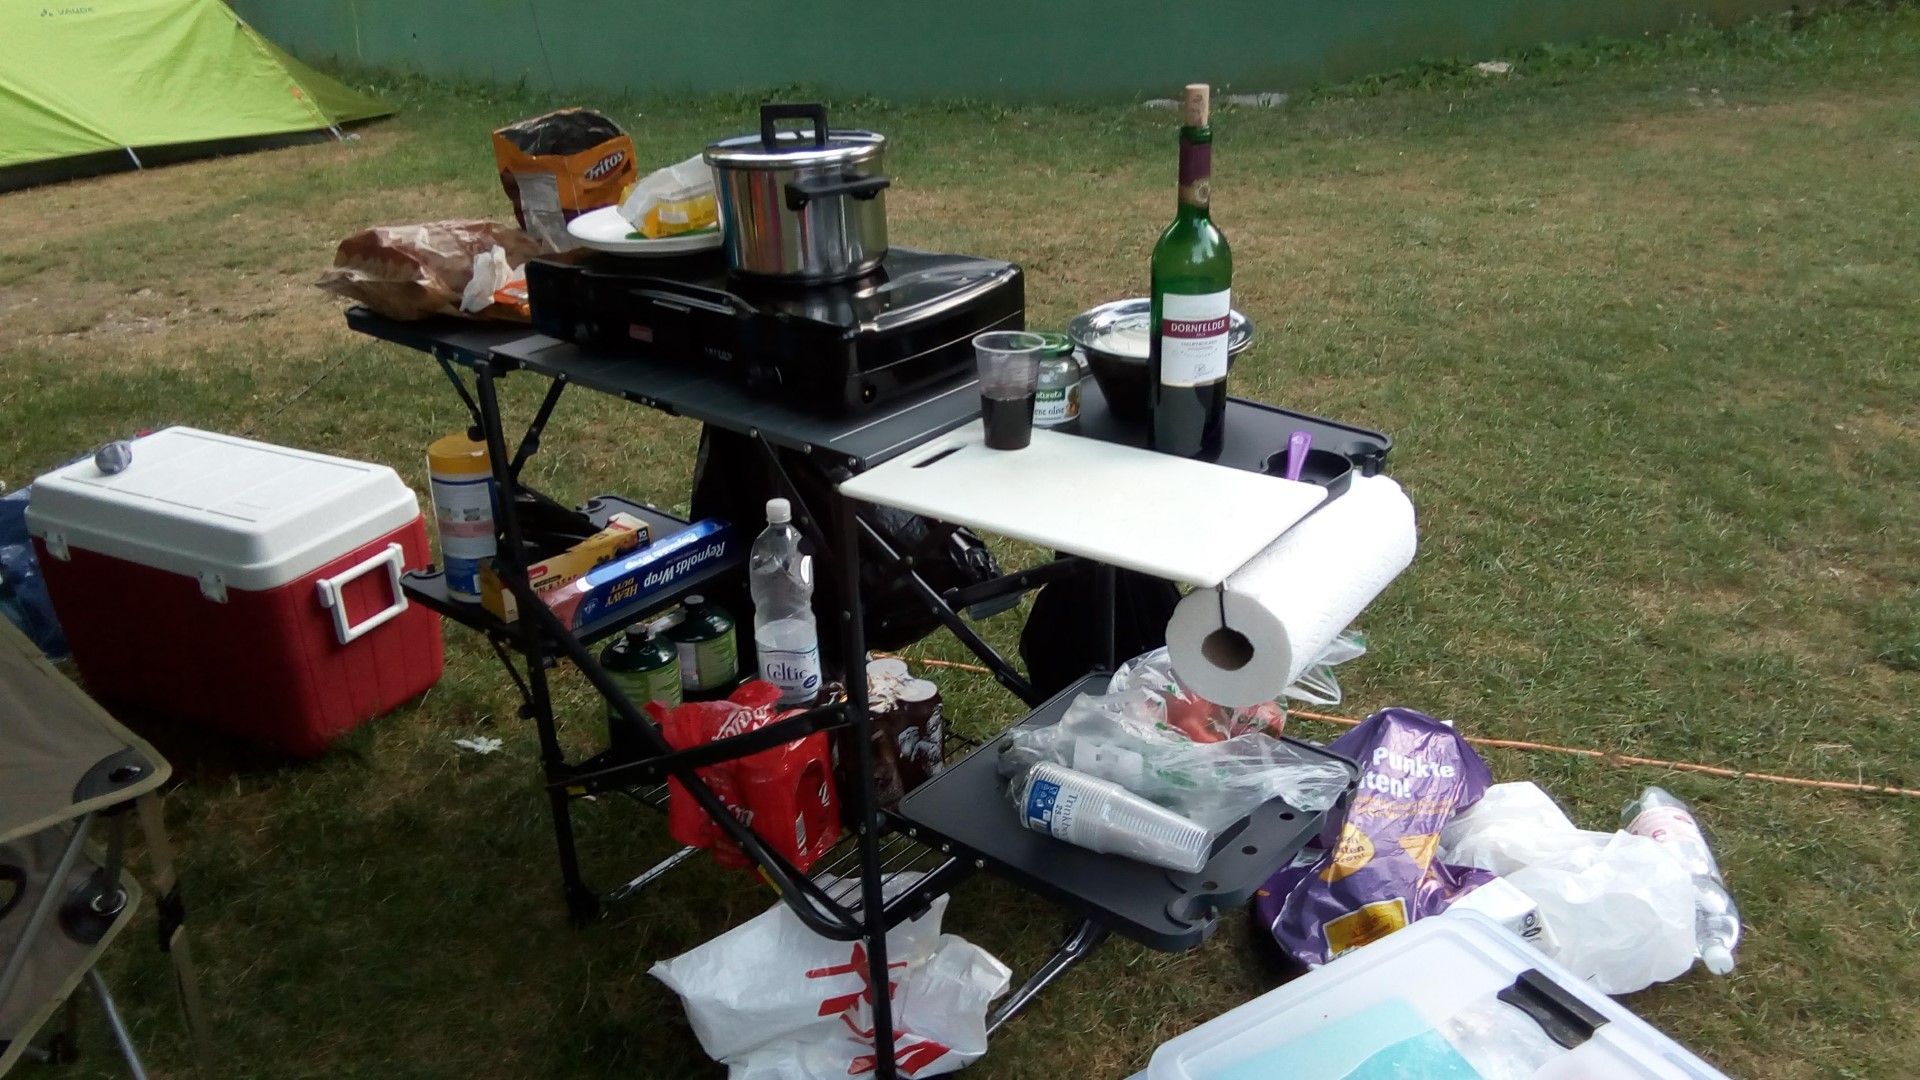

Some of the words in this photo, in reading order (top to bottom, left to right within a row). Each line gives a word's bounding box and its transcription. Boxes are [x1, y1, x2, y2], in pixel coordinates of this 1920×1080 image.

[584, 152, 623, 181] Fritos
[1171, 319, 1226, 333] DORNFELDER
[677, 541, 726, 575] Reynolds
[610, 577, 635, 594] DUTY
[643, 567, 675, 588] Wrap
[605, 584, 638, 607] HEAVY
[766, 662, 807, 681] Celtic
[1373, 746, 1455, 779] Punkte
[1358, 772, 1412, 799] ten!
